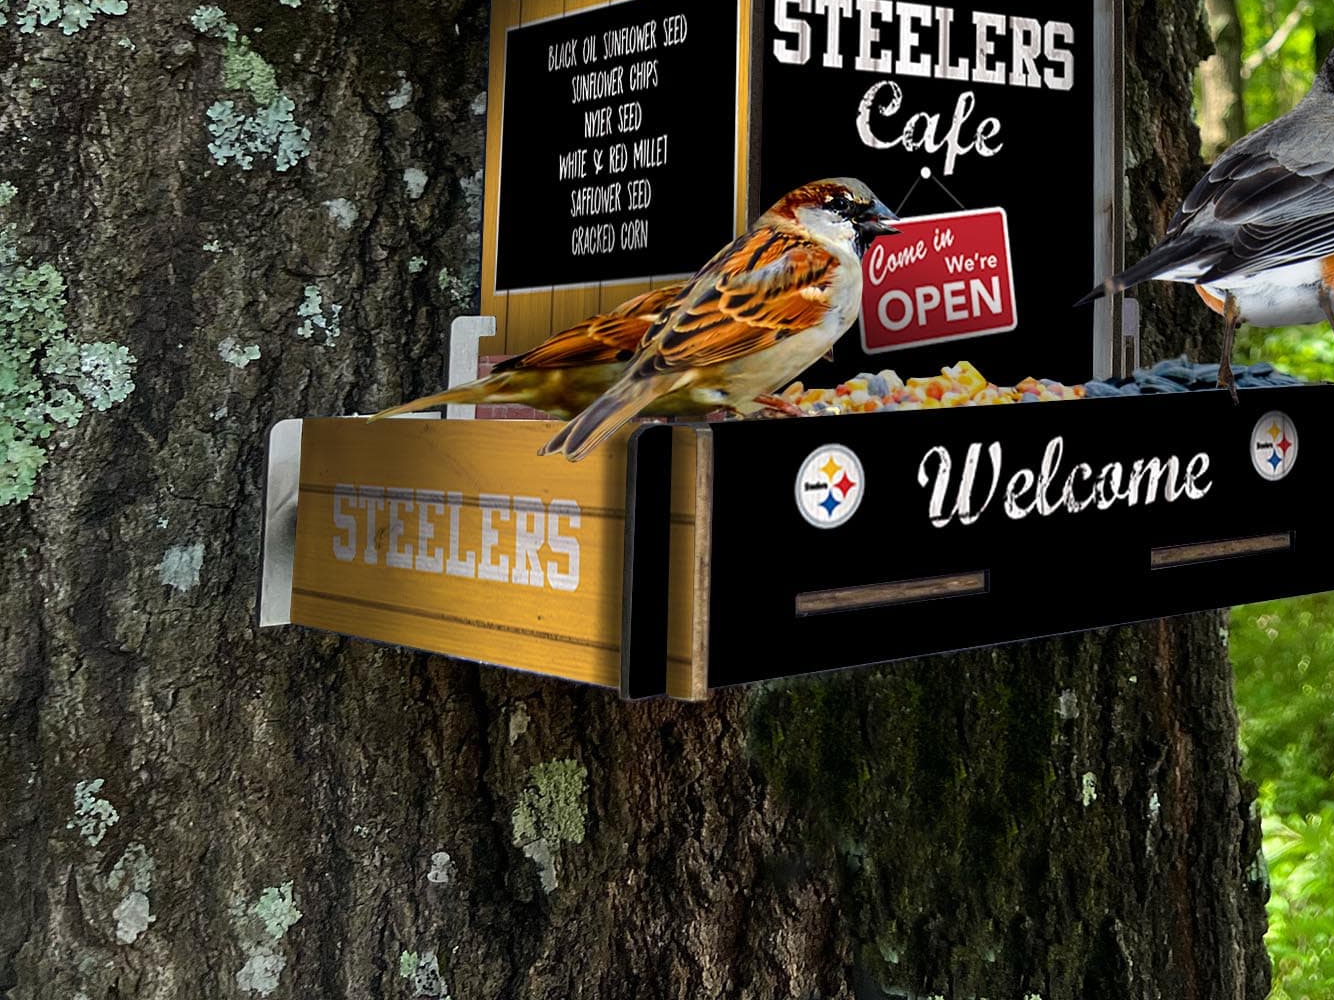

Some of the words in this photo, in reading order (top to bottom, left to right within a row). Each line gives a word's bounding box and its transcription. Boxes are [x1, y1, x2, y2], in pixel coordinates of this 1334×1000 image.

[548, 37, 578, 72] BLACK
[582, 34, 598, 65] OIL
[603, 19, 657, 60] SUNFLOWER
[663, 13, 688, 47] SEED
[571, 65, 624, 104] SUNFLOWER
[629, 59, 659, 88] CHIPS
[584, 106, 612, 138] NYJER
[617, 101, 643, 133] SEED
[855, 80, 1004, 176] Cafe
[559, 148, 588, 181] WHITE
[593, 148, 604, 175] &
[609, 142, 628, 174] RED
[633, 134, 668, 169] MILLET
[570, 182, 621, 217] SAFFLOWER
[627, 178, 652, 211] SEED
[571, 222, 615, 256] CRACKED
[620, 218, 649, 250] CORN
[869, 240, 928, 286] Come
[933, 227, 954, 252] in
[944, 251, 998, 274] We're
[877, 275, 1003, 331] OPEN
[917, 436, 1213, 528] Welcome
[332, 483, 582, 592] STEELERS
